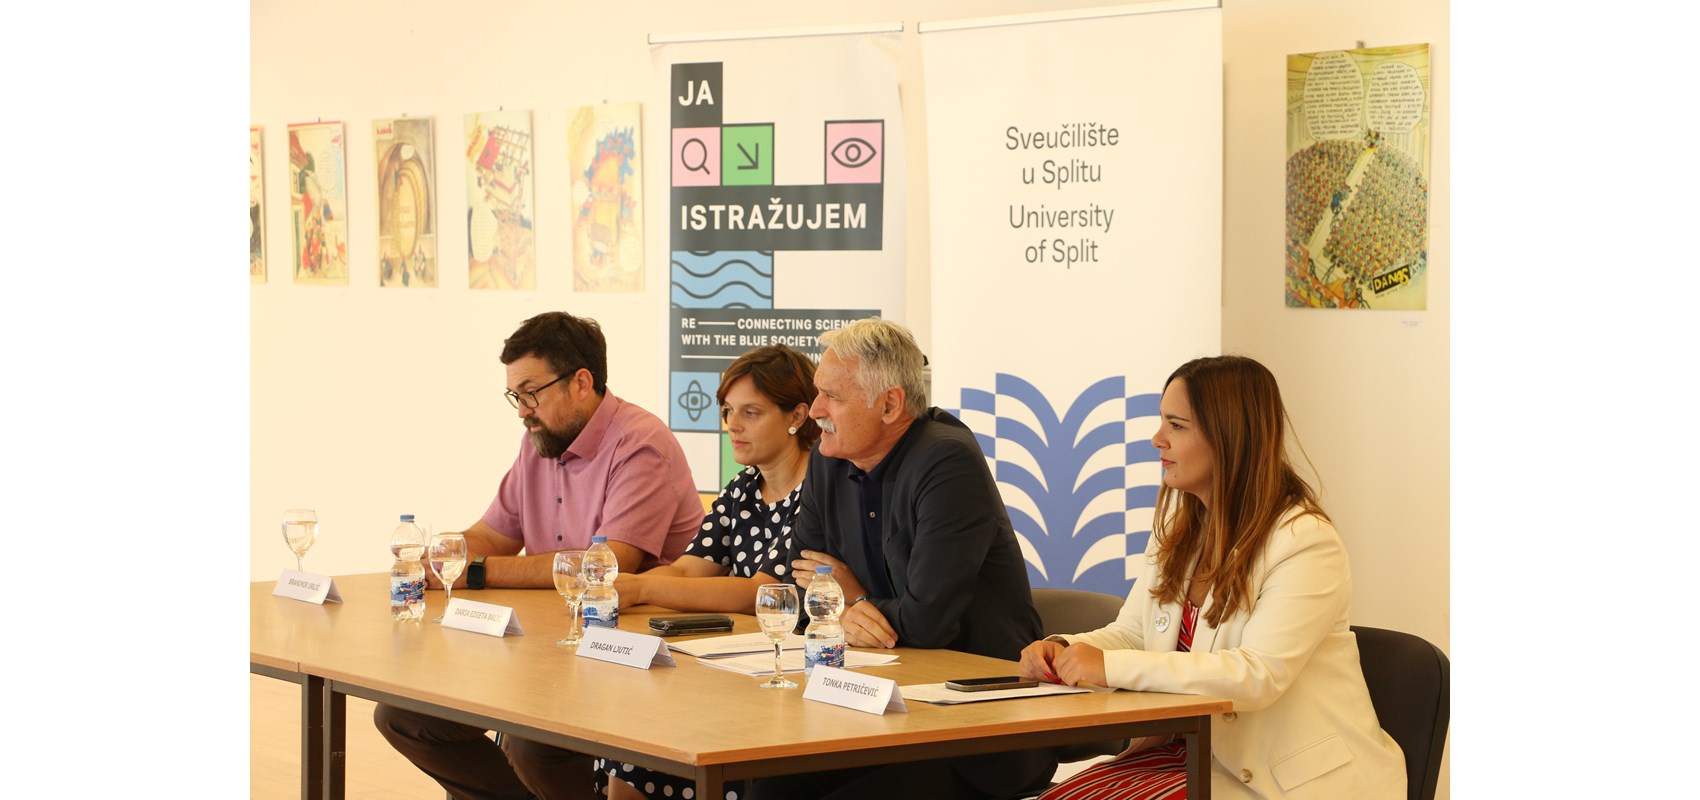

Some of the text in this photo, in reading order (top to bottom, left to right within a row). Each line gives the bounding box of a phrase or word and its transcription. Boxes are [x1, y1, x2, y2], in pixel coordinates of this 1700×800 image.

[678, 80, 714, 106] JA
[1005, 122, 1119, 150] Sveučilište
[1022, 159, 1101, 190] u Splitu
[681, 197, 867, 230] ISTRAŽUJEM
[1009, 203, 1114, 233] University
[1025, 238, 1098, 269] of Split
[1373, 267, 1409, 291] DANAS
[681, 318, 696, 329] RE
[737, 318, 812, 330] CONNECTING
[681, 334, 821, 347] WITH THE BLUE SOCIETY
[590, 641, 634, 655] DRAGAN LJUTIĆ
[822, 677, 880, 697] TONKA PETRIČEVIĆ
